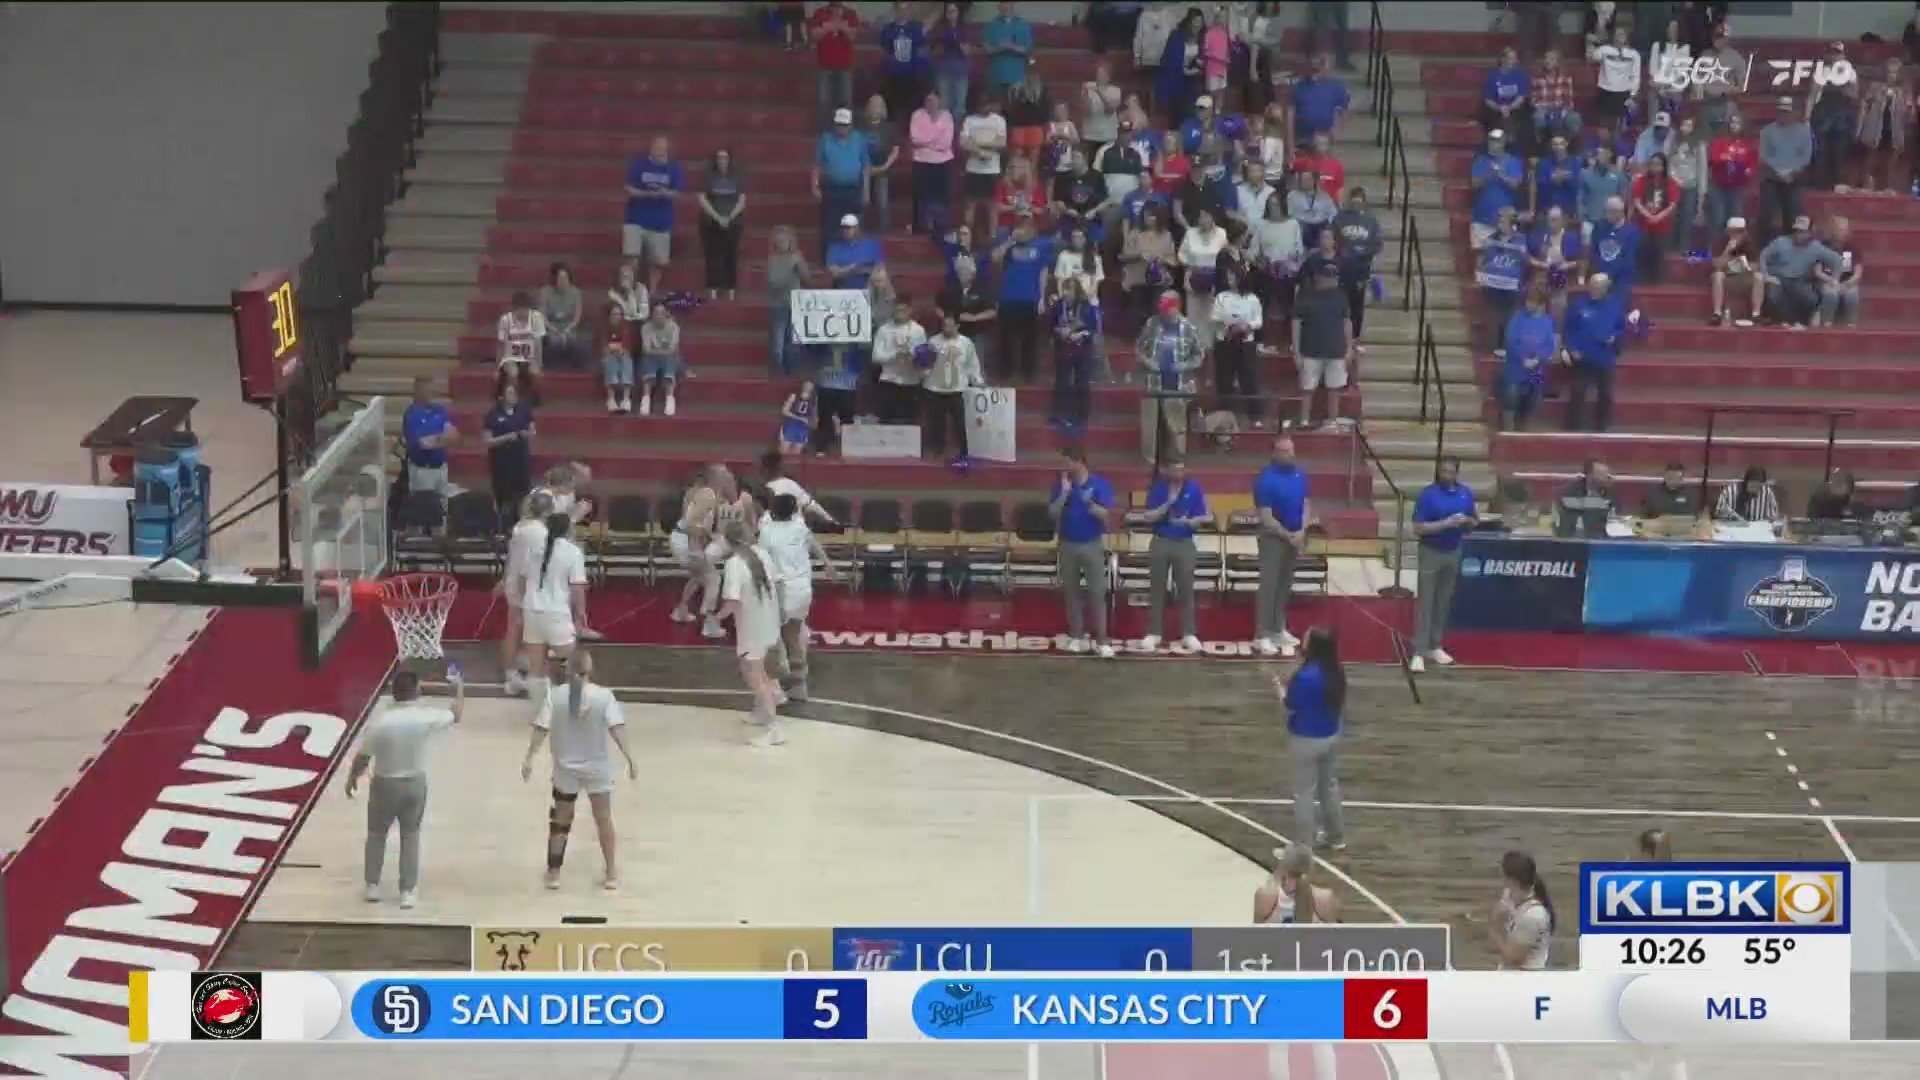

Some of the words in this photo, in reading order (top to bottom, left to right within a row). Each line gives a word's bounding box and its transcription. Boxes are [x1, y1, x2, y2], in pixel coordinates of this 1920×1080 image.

[268, 281, 297, 358] 30
[803, 313, 862, 338] LCU
[1483, 558, 1577, 578] BASKETBALL
[1746, 594, 1834, 608] CHAMPIONSHIP
